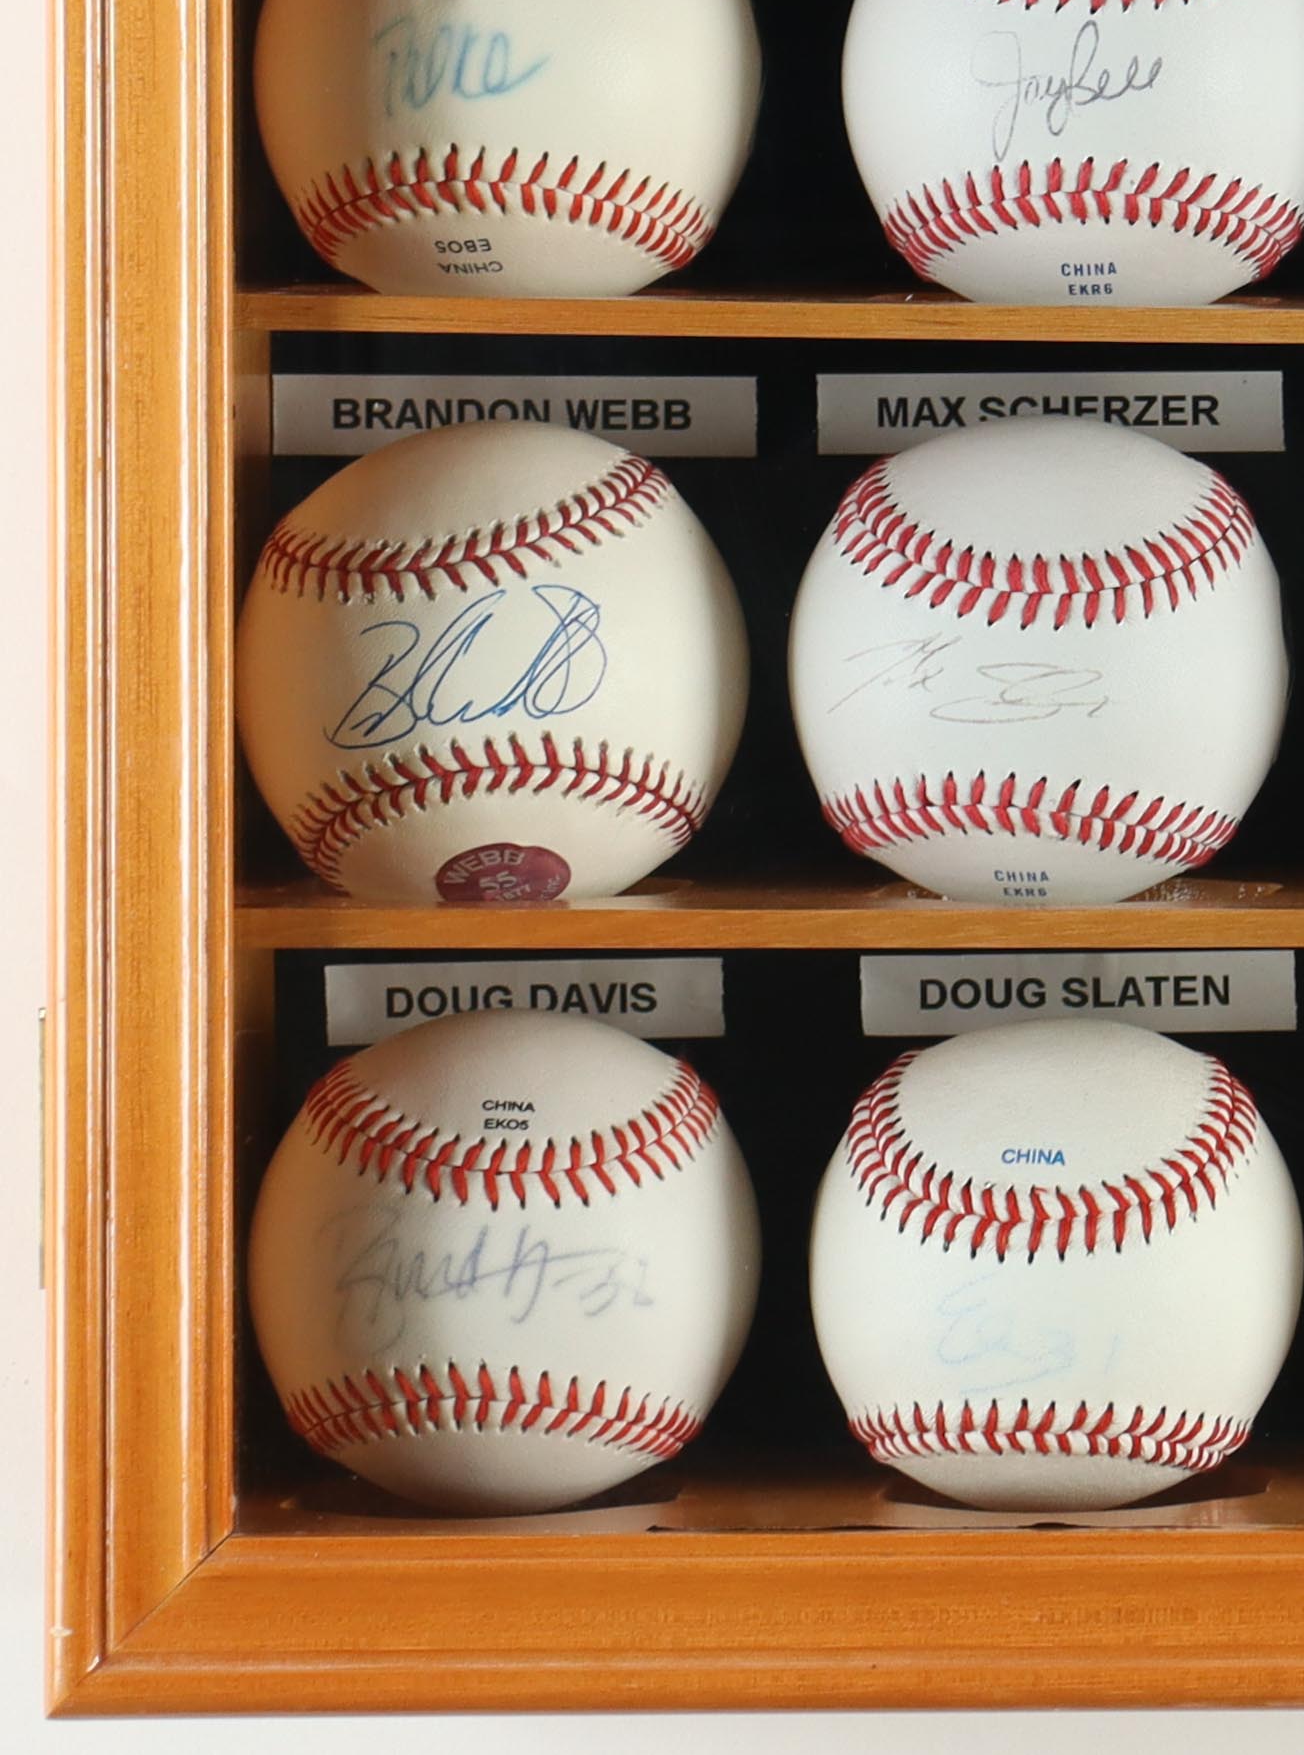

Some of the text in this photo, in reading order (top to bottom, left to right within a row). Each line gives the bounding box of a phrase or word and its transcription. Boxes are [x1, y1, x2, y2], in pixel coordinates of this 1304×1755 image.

[437, 260, 504, 275] CHINA
[1060, 261, 1117, 277] CHINA
[1068, 283, 1113, 296] EKR6
[332, 398, 692, 431] BRANDON WEBB
[877, 394, 1220, 428] MAX SCHERZER
[443, 848, 525, 884] WEBB
[993, 869, 1049, 882] CHINA
[1003, 887, 1048, 898] EKR6
[386, 982, 657, 1019] DOUG DAVIS
[920, 975, 1230, 1010] DOUG SLATEN
[481, 1099, 536, 1113] CHINA
[1001, 1148, 1066, 1166] CHINA
